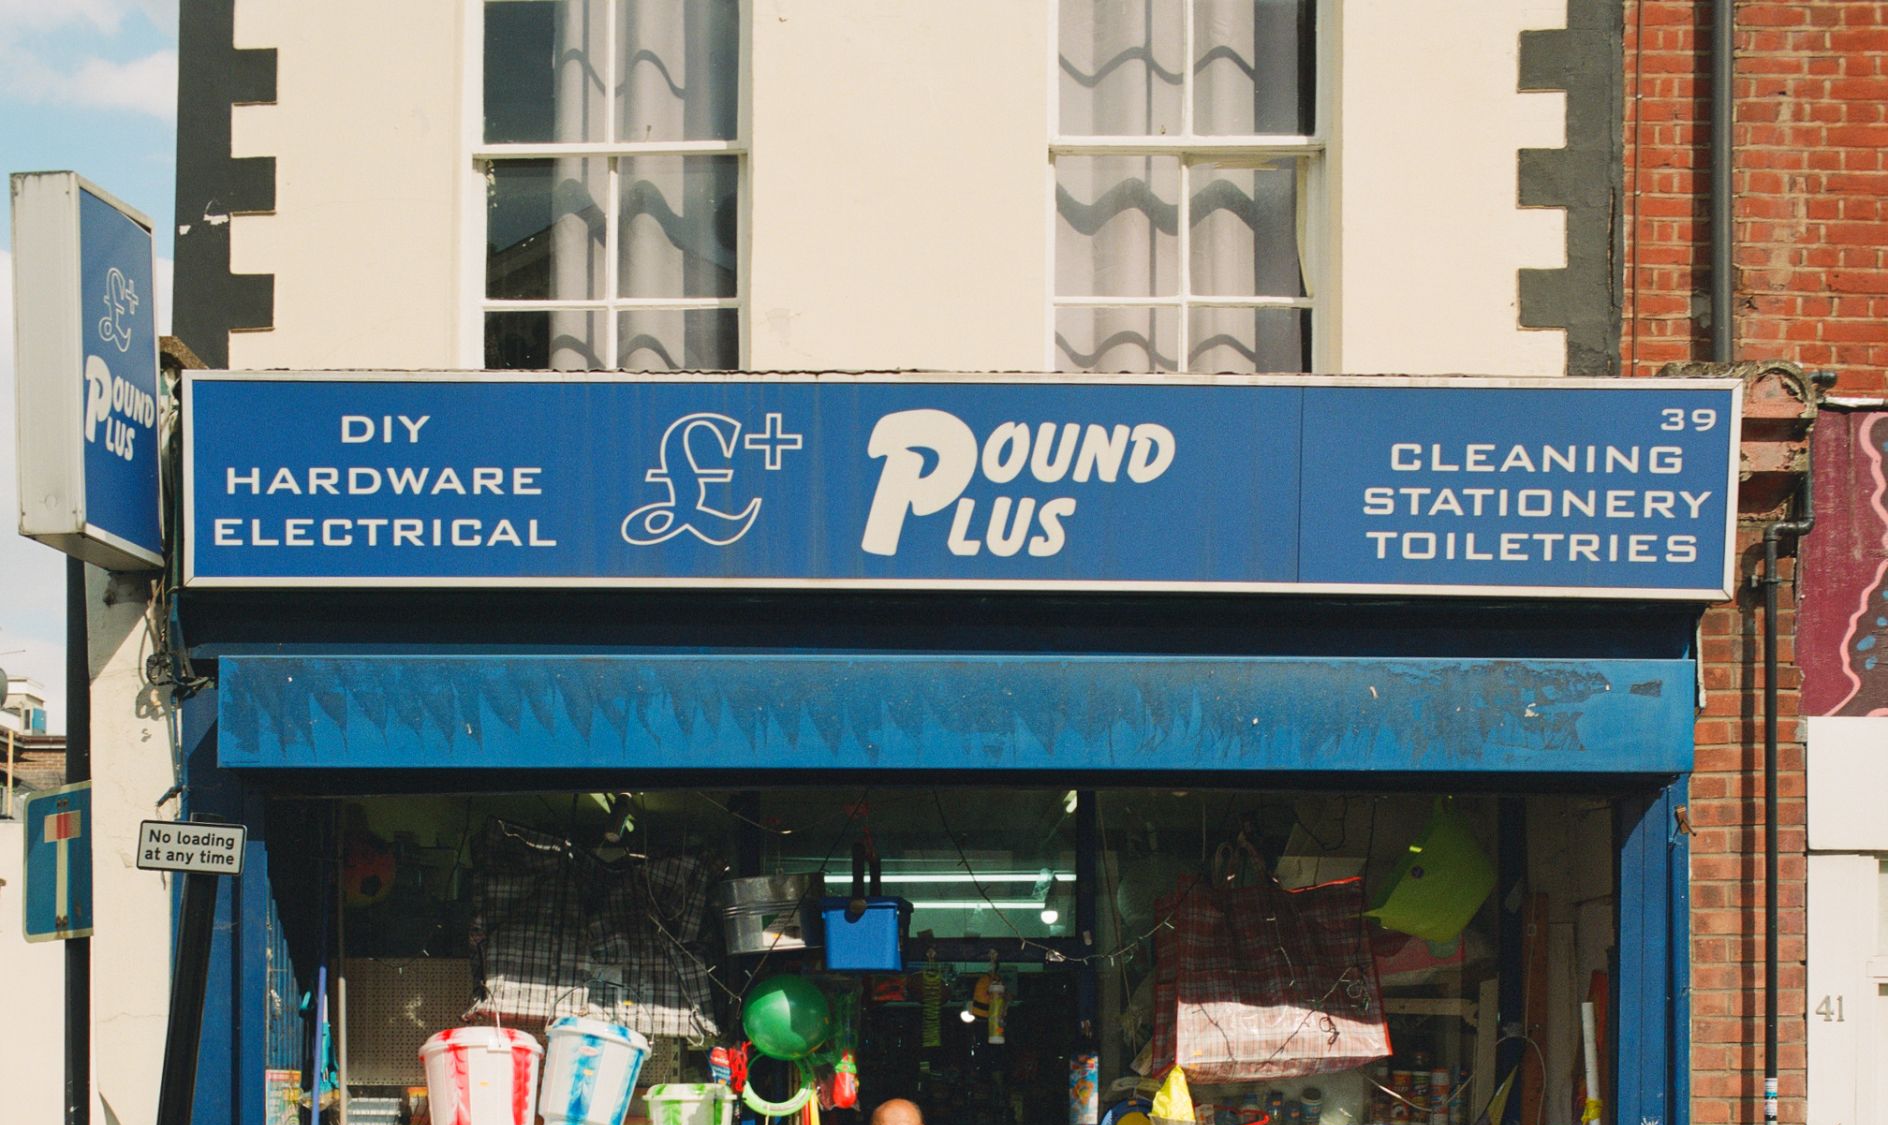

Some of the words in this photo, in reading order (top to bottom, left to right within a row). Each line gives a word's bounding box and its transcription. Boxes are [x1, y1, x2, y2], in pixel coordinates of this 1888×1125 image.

[85, 355, 155, 443] POUND
[340, 414, 432, 444] DIY
[1660, 408, 1718, 432] 39
[1390, 442, 1684, 475] CLEANING
[225, 466, 543, 496] HARDWARE
[861, 408, 1176, 556] POUND
[1362, 486, 1713, 519] STATIONERY
[213, 518, 558, 547] ELECTRICAL
[1365, 530, 1698, 563] TOILETRIES
[149, 829, 171, 844] No
[177, 831, 235, 850] loading
[144, 847, 161, 860] at
[166, 851, 194, 865] any
[200, 850, 235, 865] time
[1815, 994, 1846, 1023] 41
